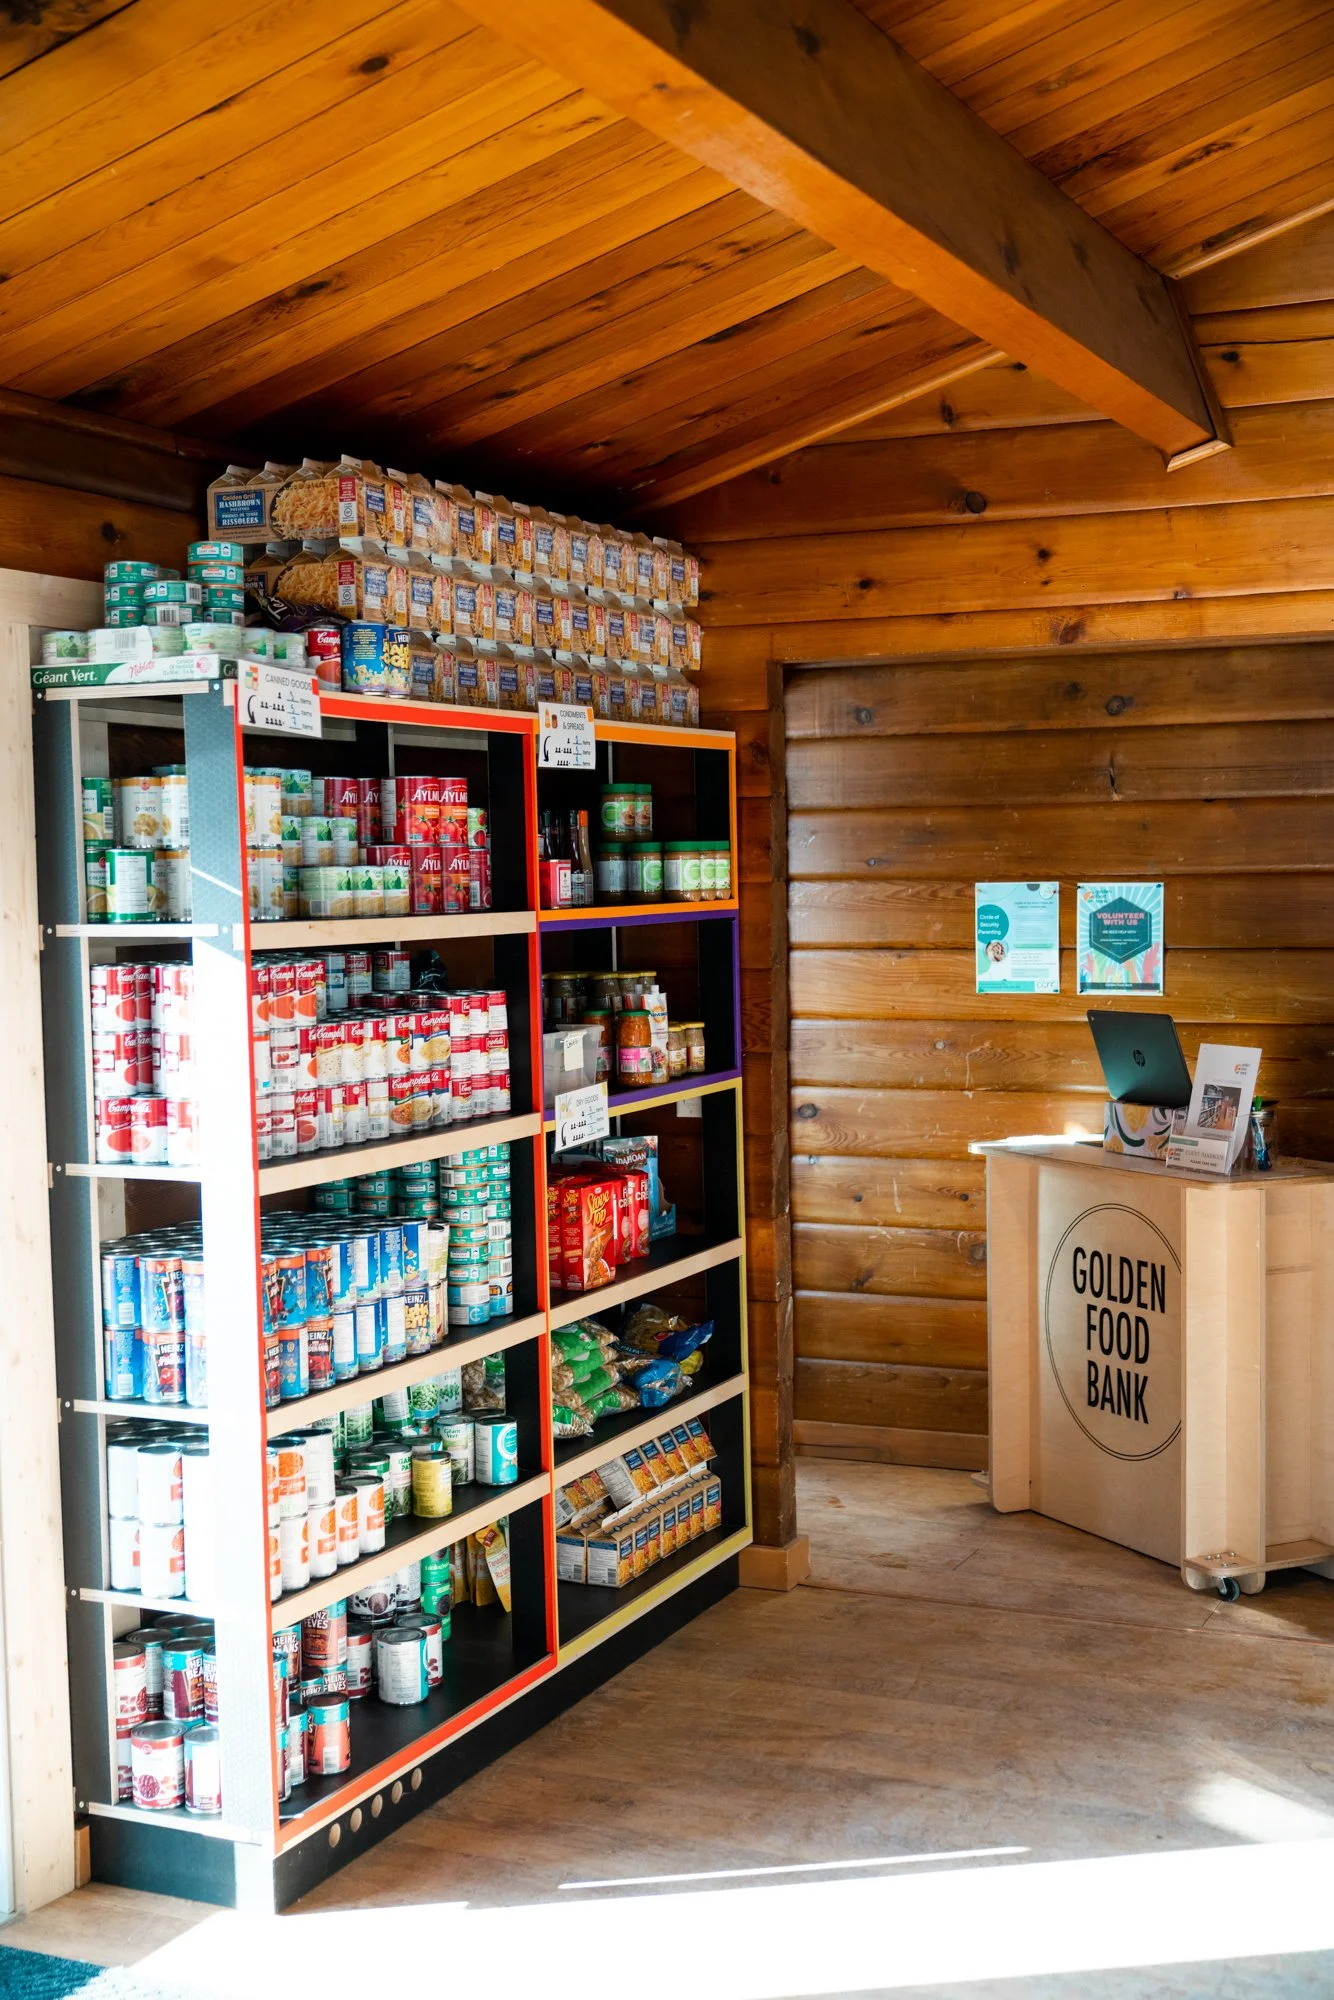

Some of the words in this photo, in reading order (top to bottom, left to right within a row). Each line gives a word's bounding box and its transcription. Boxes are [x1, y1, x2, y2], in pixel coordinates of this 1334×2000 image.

[219, 499, 261, 508] HASHBROWN
[32, 670, 69, 684] Géant
[265, 673, 290, 687] CANNED
[290, 679, 312, 691] GOODS
[560, 709, 586, 719] CONDIMENTS
[567, 722, 584, 731] SPREADS
[1096, 912, 1145, 920] VOLUNTEER
[615, 1152, 647, 1165] IDAHOAN
[585, 1190, 610, 1224] Stove
[592, 1207, 607, 1231] Top
[1072, 1246, 1165, 1314] GOLDEN
[1086, 1303, 1150, 1365] FOOD
[1086, 1359, 1149, 1425] BANK
[273, 1635, 297, 1646] HEINZ
[324, 1674, 345, 1683] HEINZ
